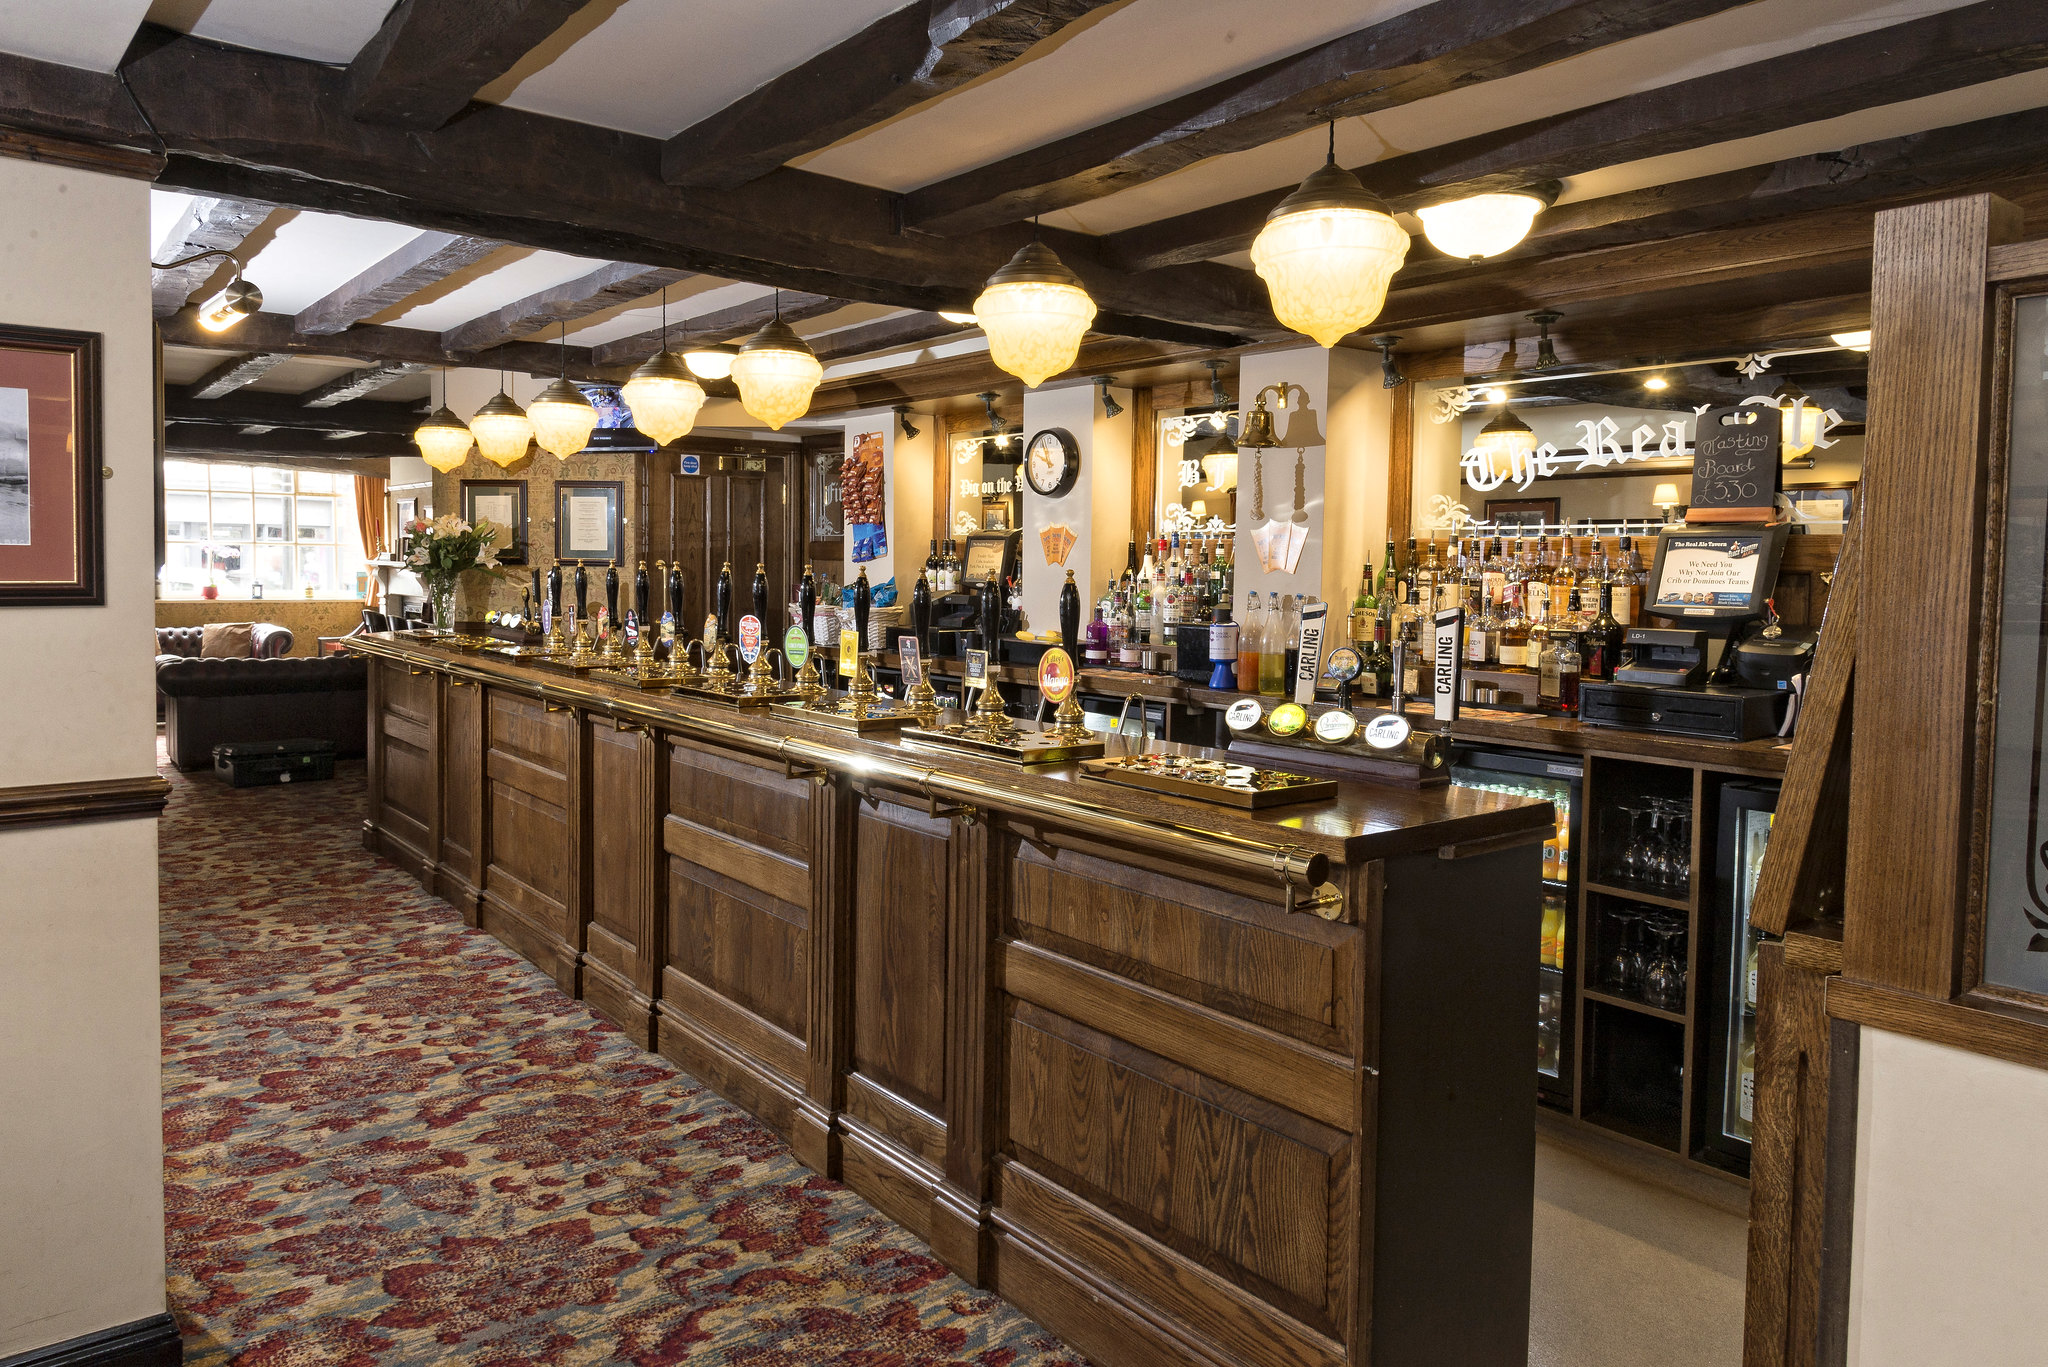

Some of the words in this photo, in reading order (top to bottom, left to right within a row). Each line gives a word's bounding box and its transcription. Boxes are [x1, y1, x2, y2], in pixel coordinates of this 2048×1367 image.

[1700, 433, 1769, 456] Tasting
[1459, 437, 1560, 492] The
[1698, 458, 1756, 480] Board
[960, 479, 980, 498] Pig
[982, 481, 996, 494] on
[996, 477, 1013, 496] the
[1695, 480, 1758, 504] £3.30
[1679, 569, 1693, 577] Why
[1299, 628, 1320, 681] CARLING
[1436, 636, 1453, 695] CARLING
[1043, 674, 1068, 690] Mango
[1228, 712, 1254, 722] CARLING
[1369, 727, 1400, 740] CARLING
